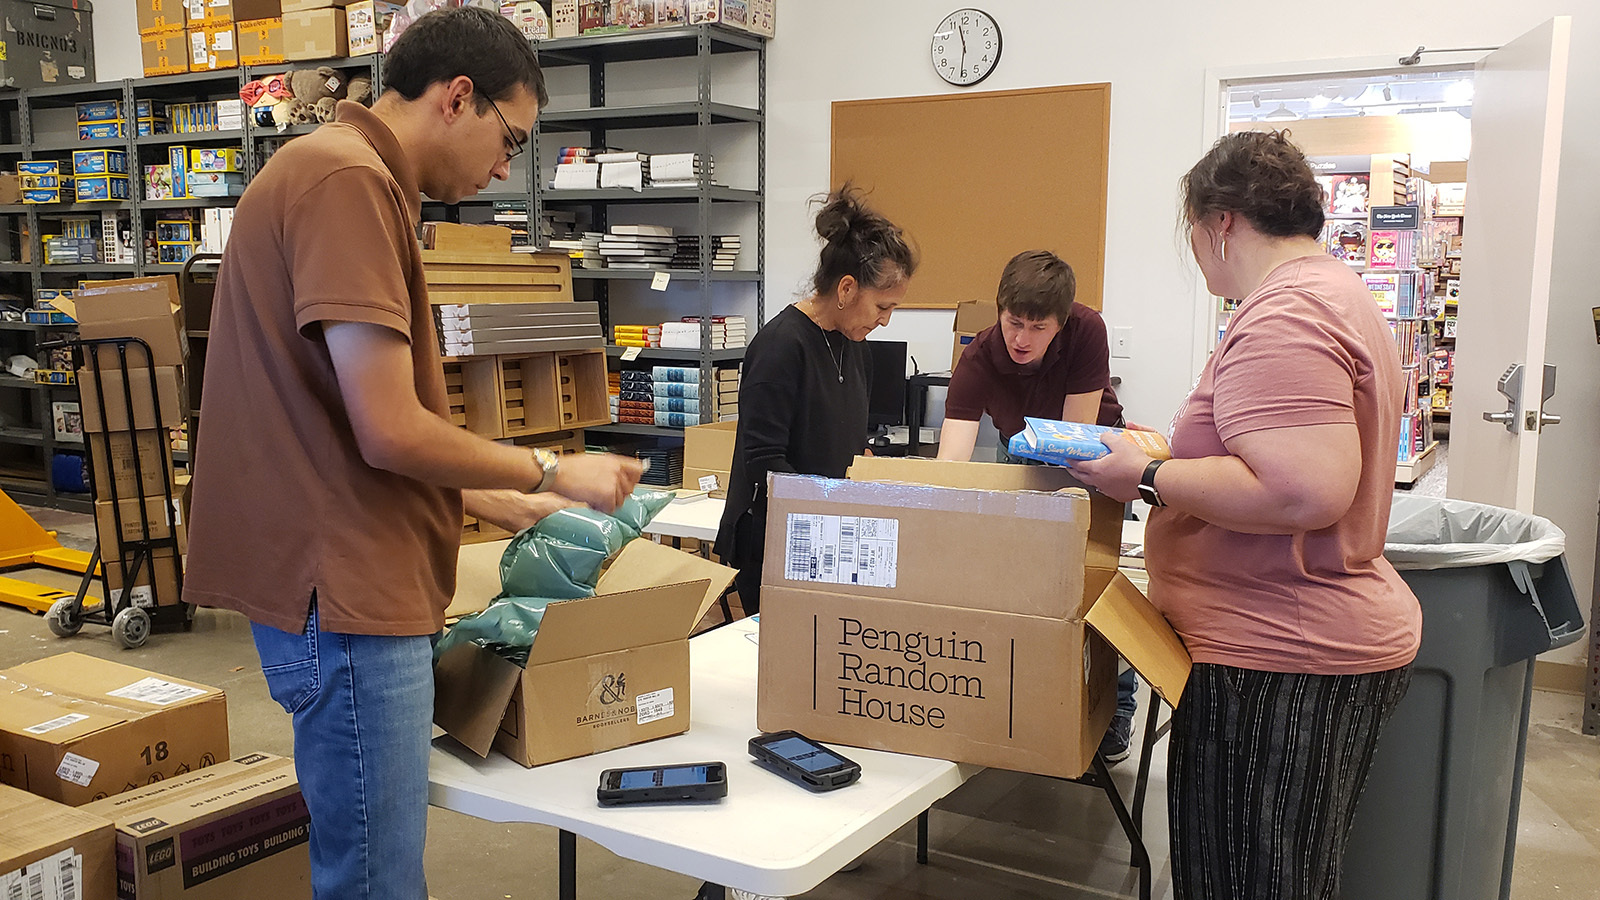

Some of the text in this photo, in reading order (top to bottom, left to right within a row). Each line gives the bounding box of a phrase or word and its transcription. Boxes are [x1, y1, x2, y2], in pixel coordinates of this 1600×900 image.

[961, 17, 969, 25] 12
[975, 19, 979, 27] 1
[983, 28, 989, 36] 2
[938, 46, 944, 54] 9
[985, 41, 991, 49] 3
[941, 59, 947, 67] 8
[982, 55, 988, 63] 4
[950, 67, 955, 75] 7
[962, 69, 967, 78] 6
[973, 65, 980, 73] 5
[838, 617, 986, 664] Penguin
[838, 653, 986, 700] Random
[838, 686, 946, 729] House
[140, 741, 169, 766] 18
[240, 783, 259, 792] WITH
[261, 774, 288, 784] RAZOR
[221, 822, 244, 837] TOYS
[249, 812, 271, 826] TOYS
[276, 801, 297, 816] TOYS
[135, 820, 161, 831] LEGO
[149, 847, 172, 865] LEGO
[192, 852, 236, 878] BUILDING
[238, 843, 259, 858] TOYS
[264, 826, 304, 850] BUILDING
[120, 879, 135, 893] TOYS
